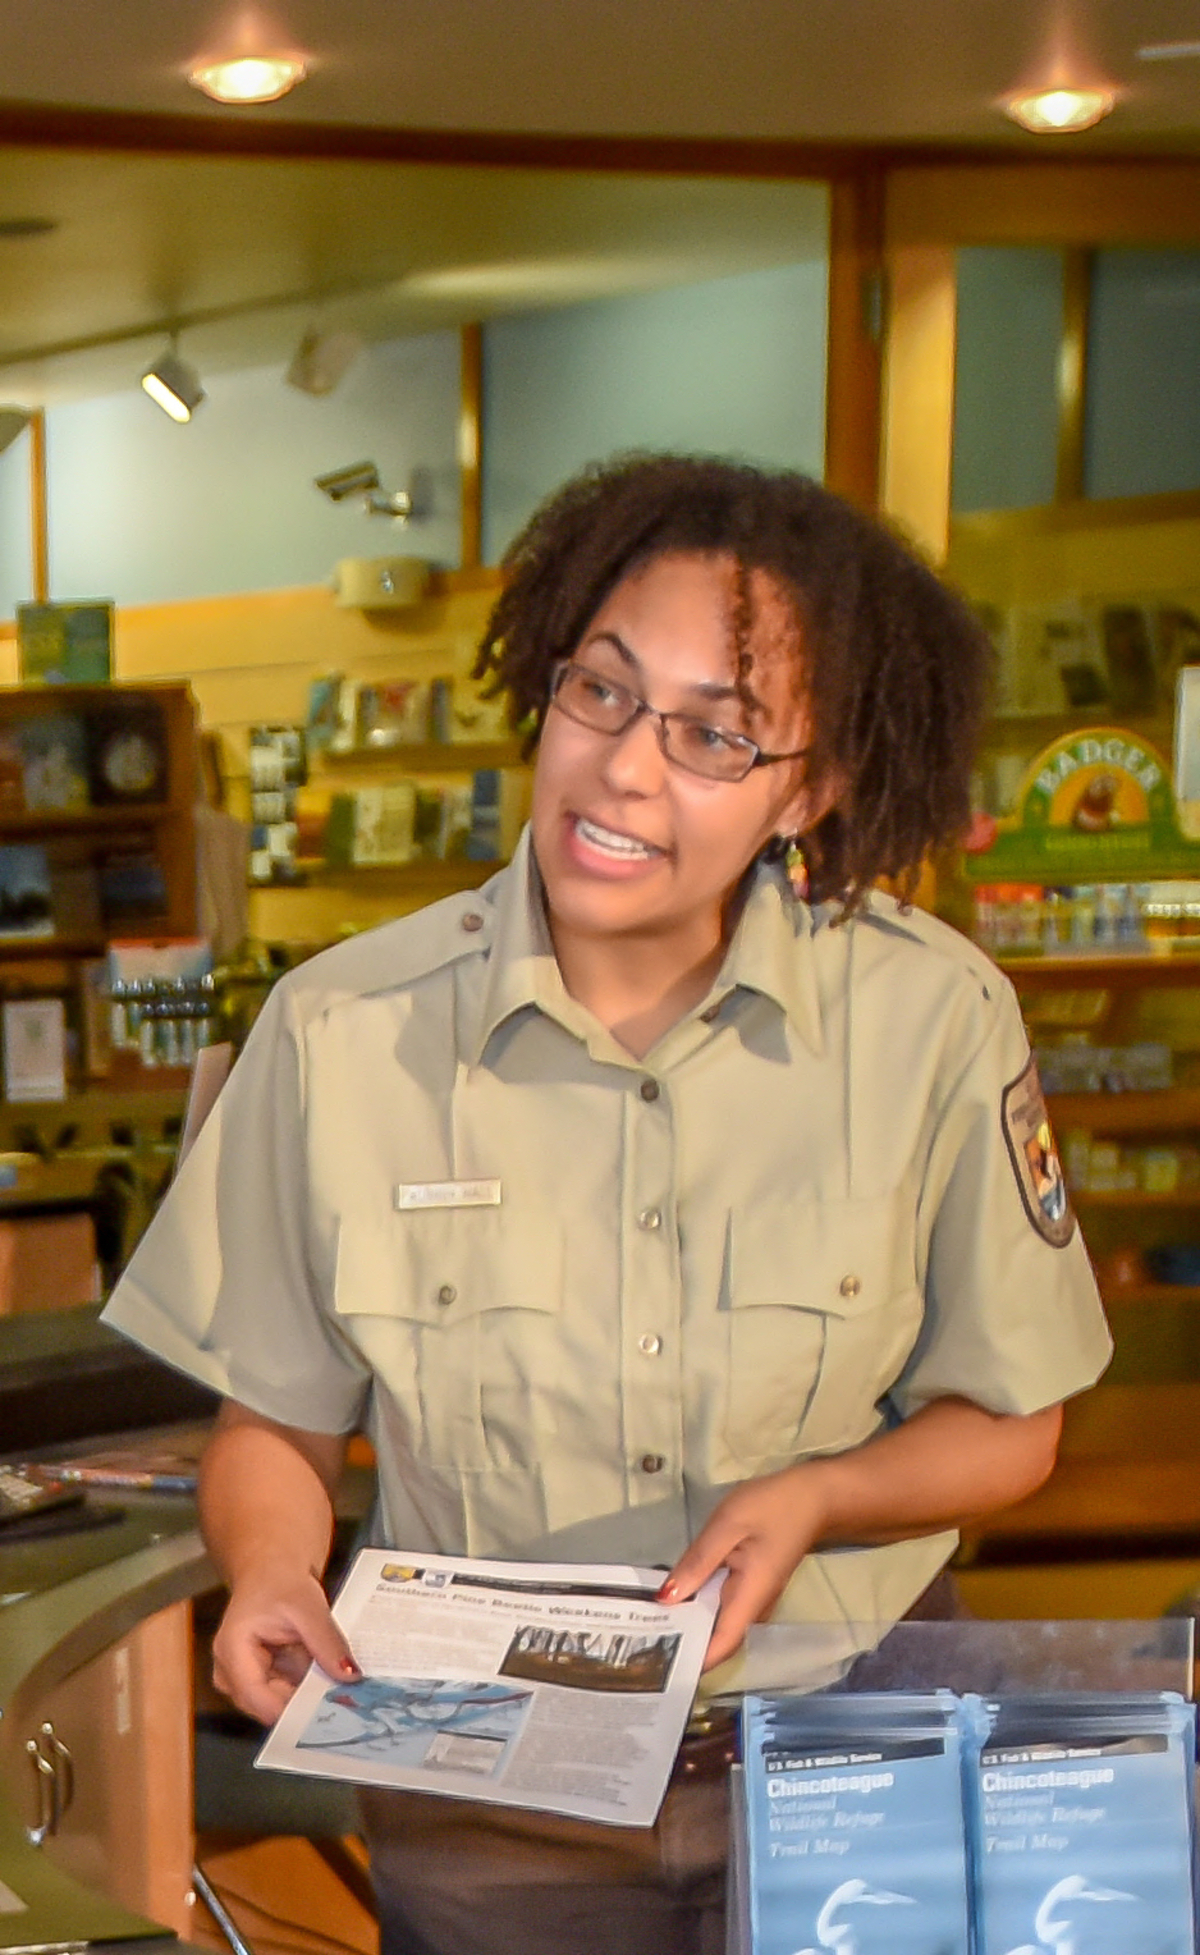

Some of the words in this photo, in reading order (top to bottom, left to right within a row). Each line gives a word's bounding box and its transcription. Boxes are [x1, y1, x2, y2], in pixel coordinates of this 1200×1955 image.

[1035, 737, 1161, 794] BADGER
[767, 1773, 893, 1797] Chincoteague
[982, 1768, 1114, 1792] Chincoteague
[770, 1841, 809, 1857] Trail
[814, 1839, 849, 1855] Map
